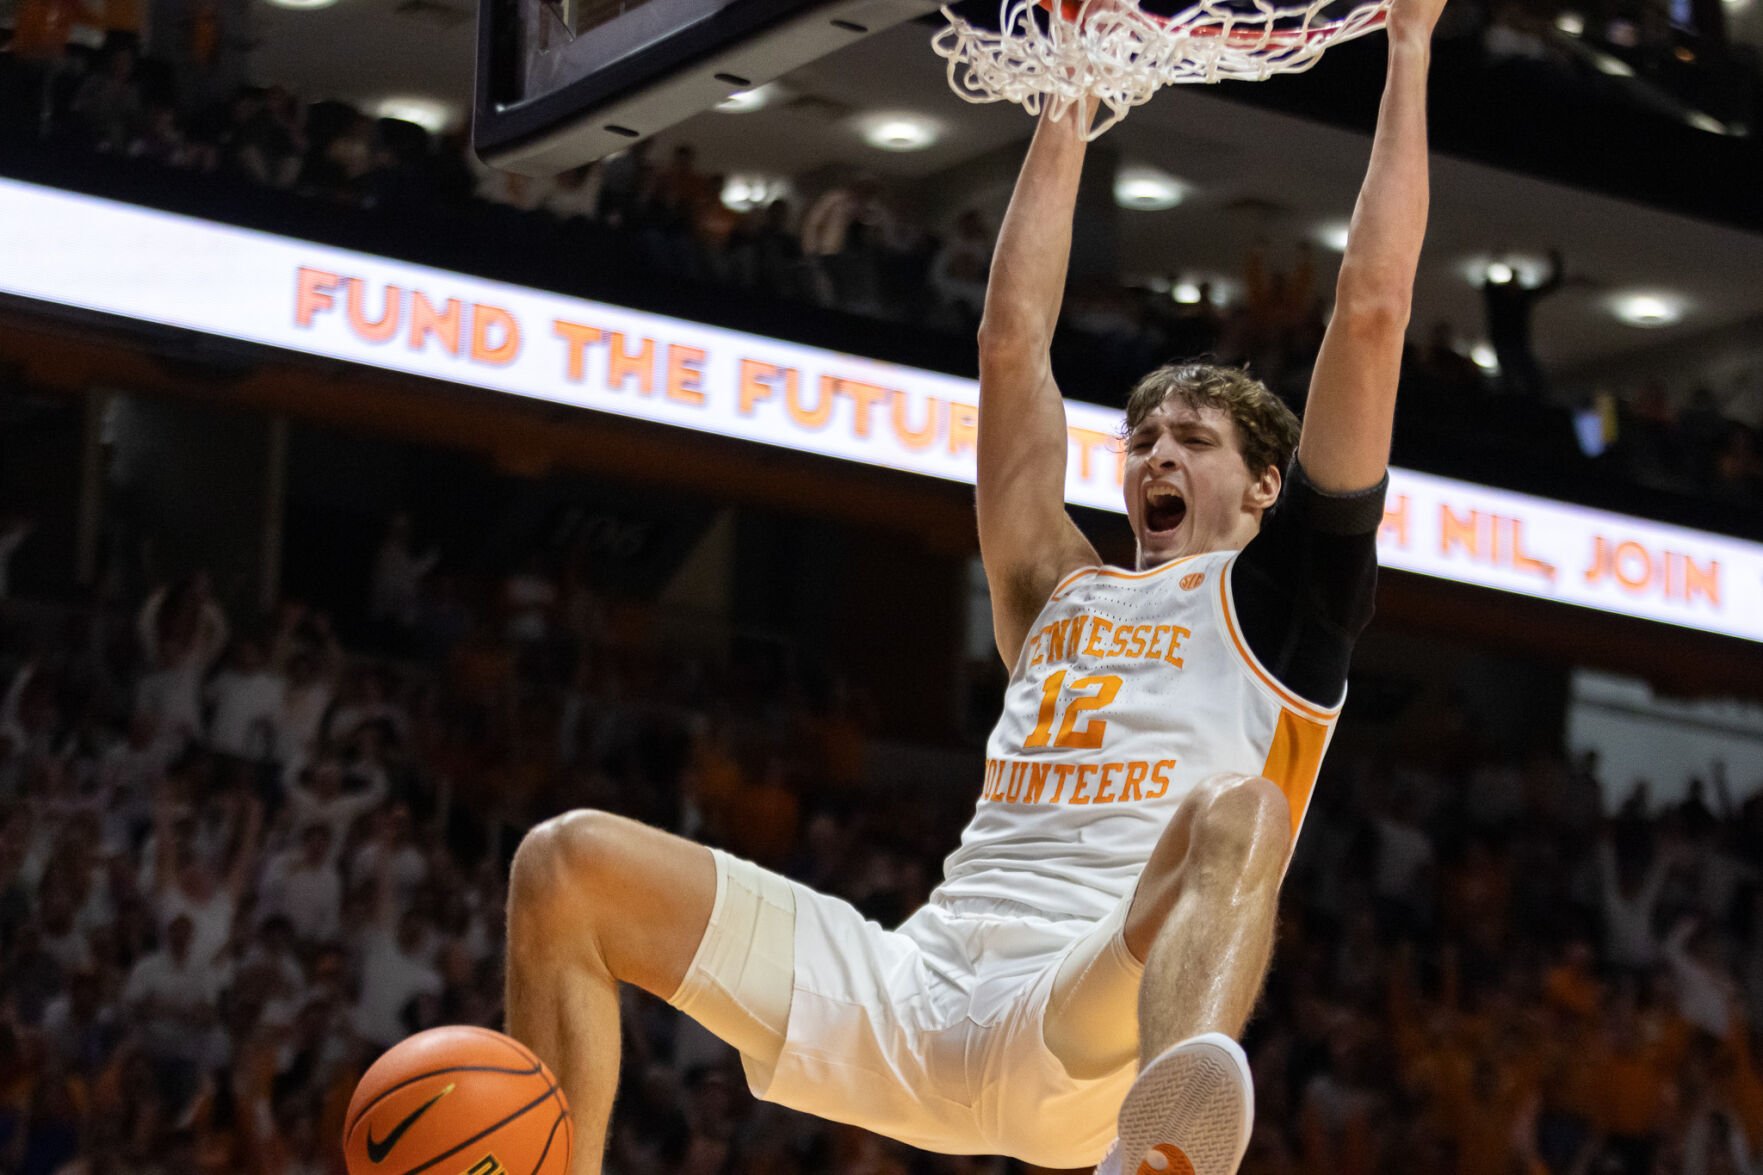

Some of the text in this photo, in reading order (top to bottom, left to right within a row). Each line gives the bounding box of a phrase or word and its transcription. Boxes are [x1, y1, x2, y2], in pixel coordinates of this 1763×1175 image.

[296, 266, 521, 364] FUND
[553, 319, 707, 404] THE
[739, 357, 978, 455] FUTUR
[1584, 535, 1721, 608] JOIN
[1023, 670, 1124, 749] 12
[984, 758, 1177, 805] OLUNTEERS
